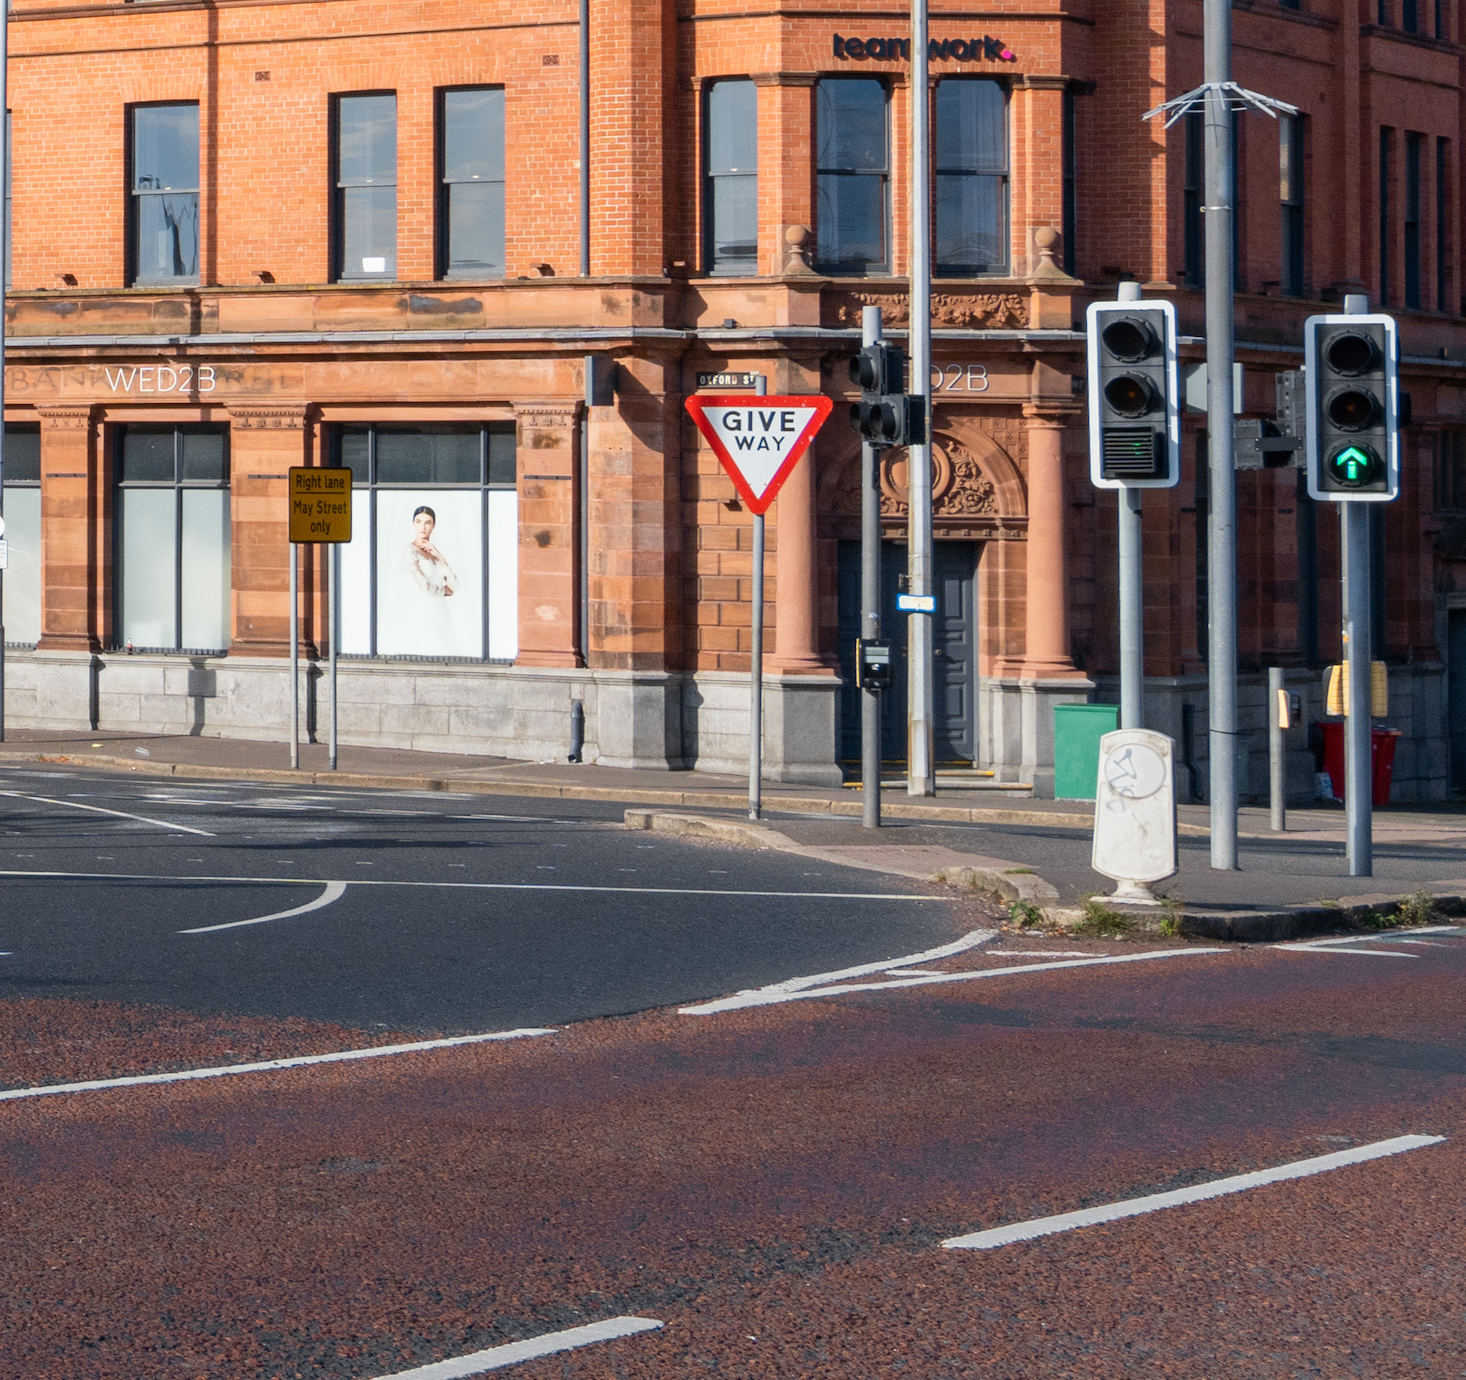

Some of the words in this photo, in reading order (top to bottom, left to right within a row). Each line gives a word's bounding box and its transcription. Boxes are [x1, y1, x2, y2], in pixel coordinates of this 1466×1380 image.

[105, 366, 216, 392] WED2B
[700, 375, 738, 385] OXFORD
[722, 410, 795, 432] GIVE
[735, 435, 785, 451] WAY
[296, 474, 322, 491] Right
[325, 475, 345, 489] lane
[293, 500, 314, 516] May
[316, 500, 348, 514] Street
[310, 519, 331, 535] only
